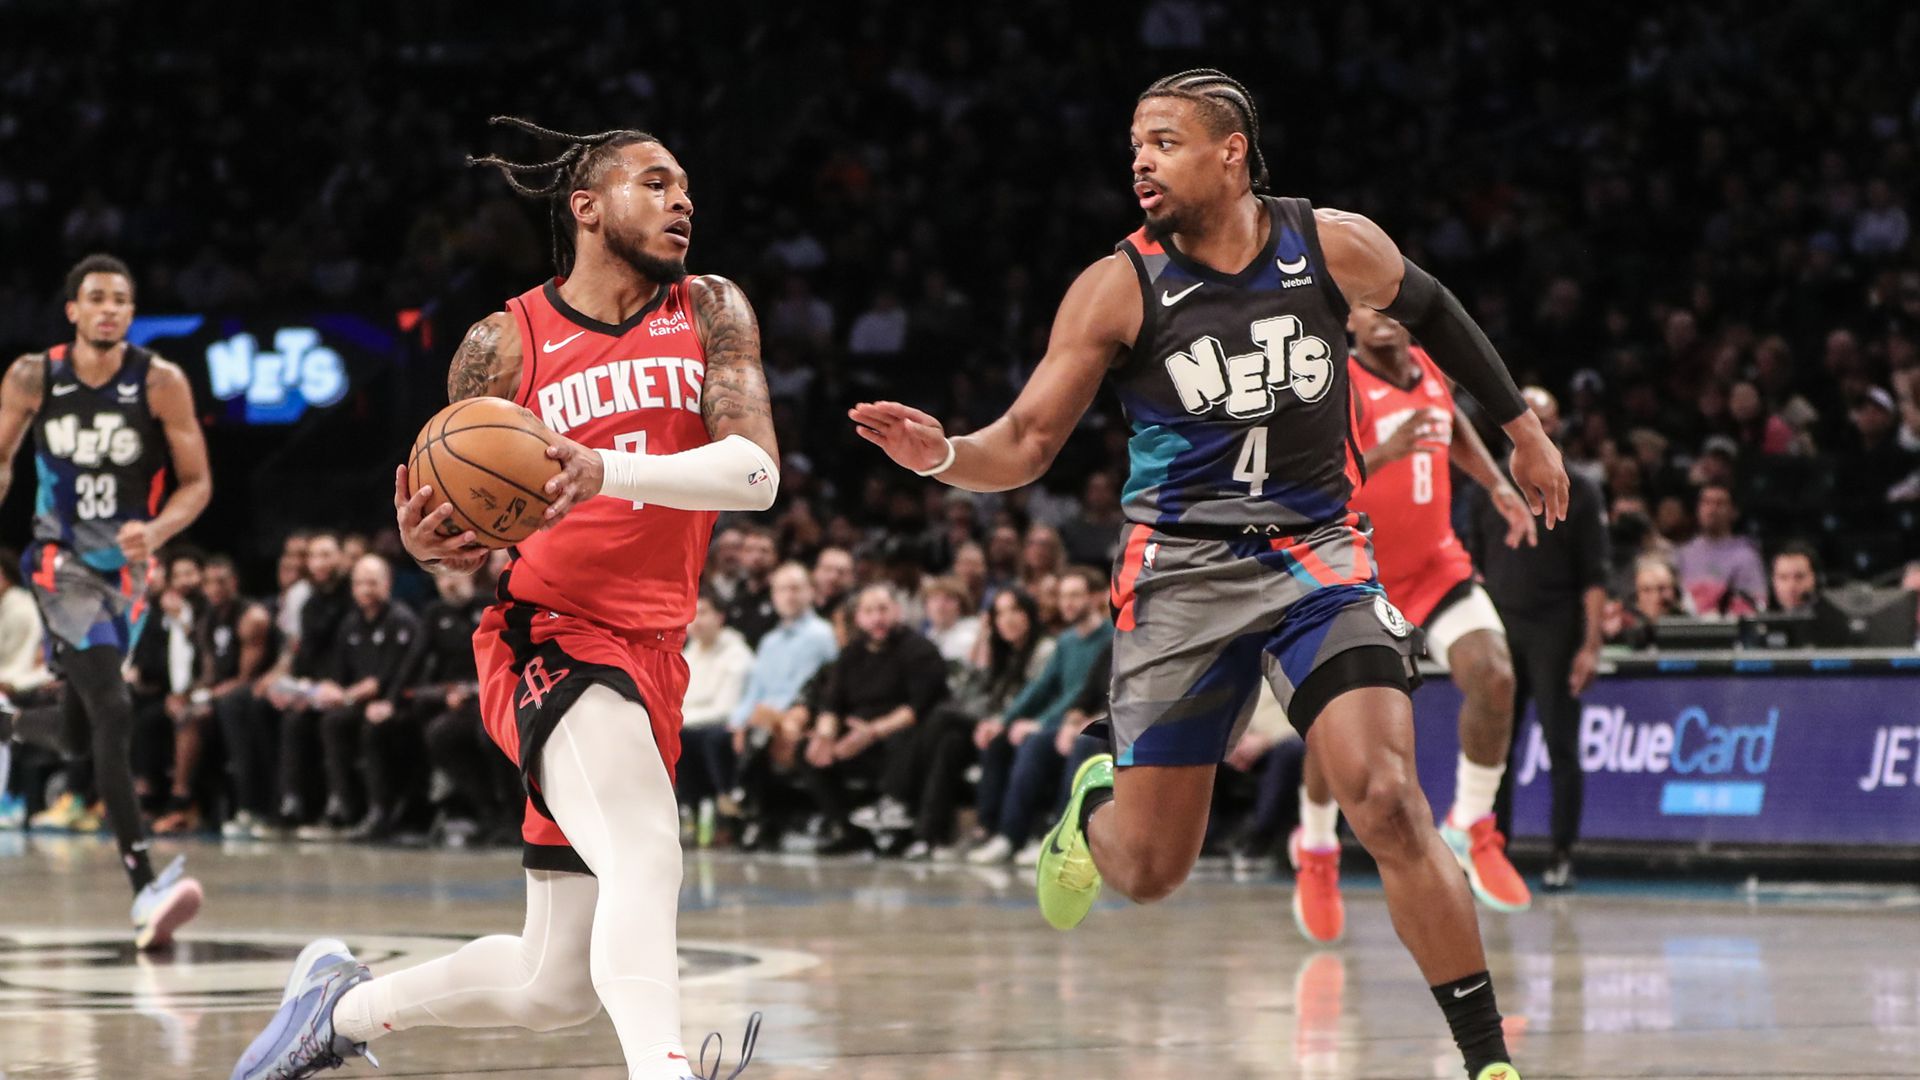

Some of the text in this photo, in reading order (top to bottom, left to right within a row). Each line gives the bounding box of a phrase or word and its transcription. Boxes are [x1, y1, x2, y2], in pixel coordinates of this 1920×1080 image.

[1282, 275, 1313, 289] Webull
[649, 321, 690, 337] karma
[206, 328, 349, 407] NETS
[1165, 314, 1334, 419] NETS
[538, 357, 705, 434] ROCKETS
[44, 412, 141, 466] NETS
[1232, 426, 1269, 496] 4
[75, 473, 118, 520] 33
[1412, 451, 1434, 505] 8
